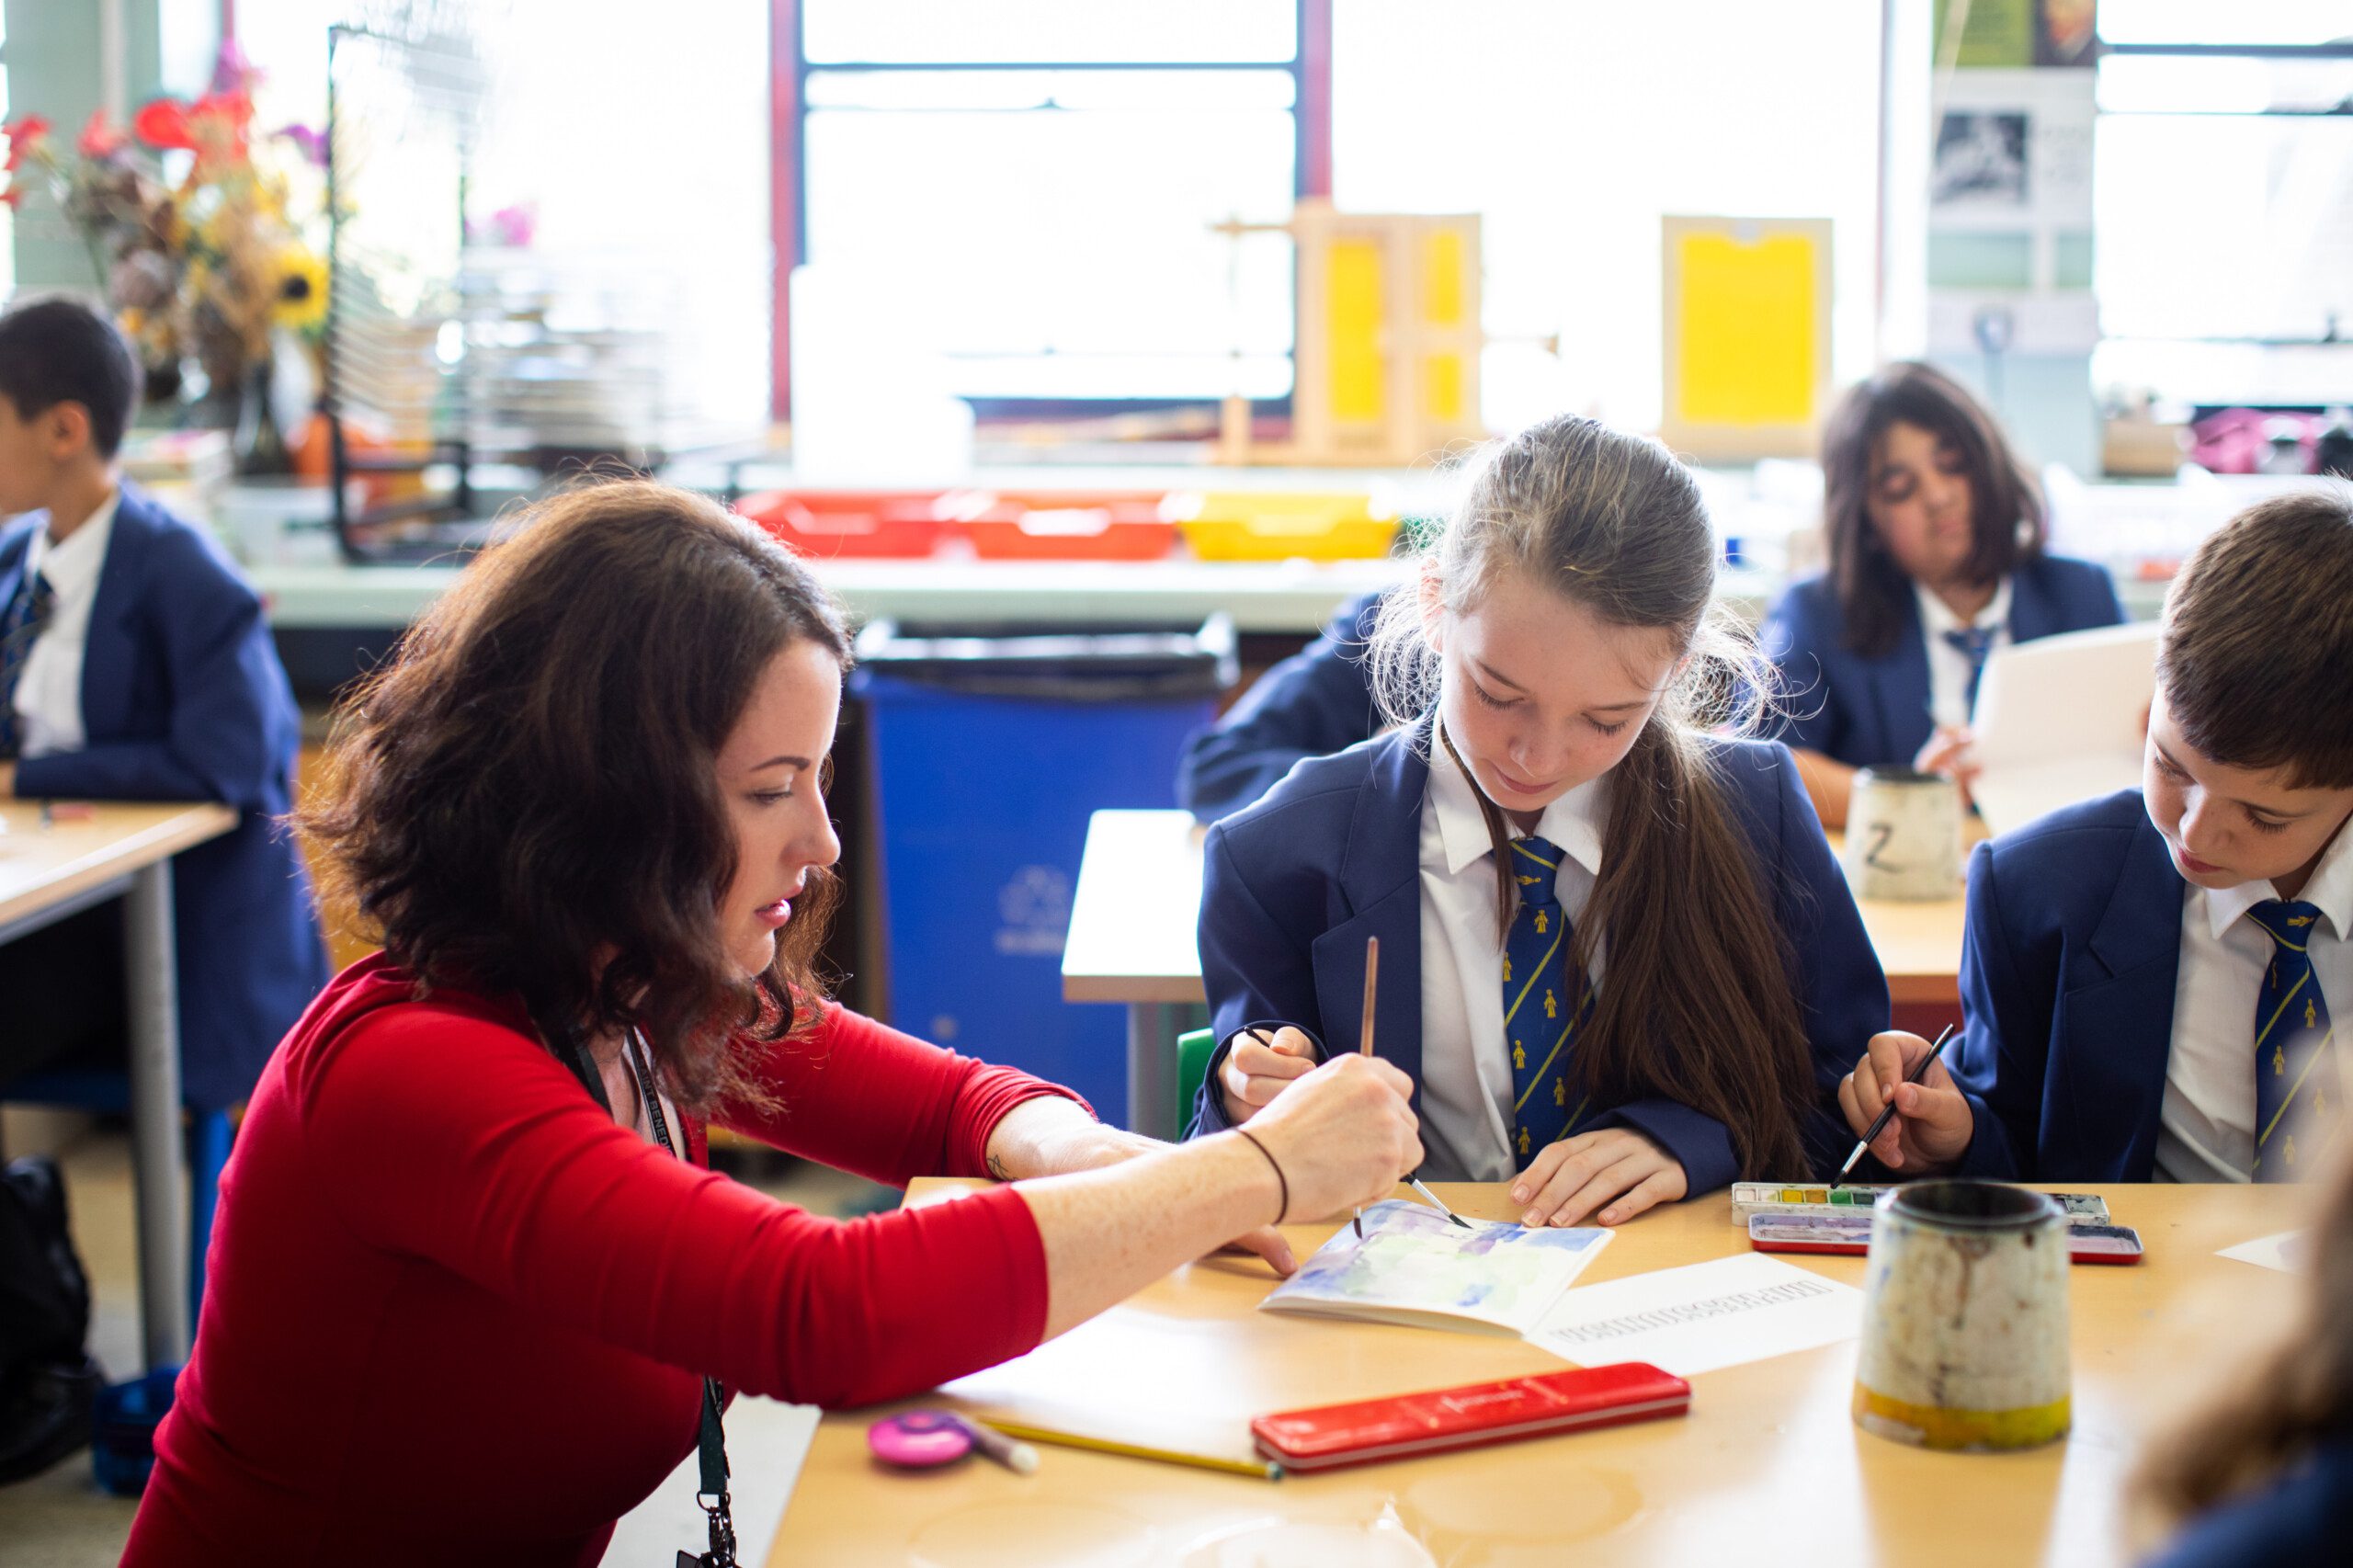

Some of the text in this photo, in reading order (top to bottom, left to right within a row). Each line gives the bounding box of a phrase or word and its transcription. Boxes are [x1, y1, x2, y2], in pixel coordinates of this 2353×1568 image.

[1866, 822, 1905, 876] 2
[639, 1058, 673, 1156] SAINT BENED
